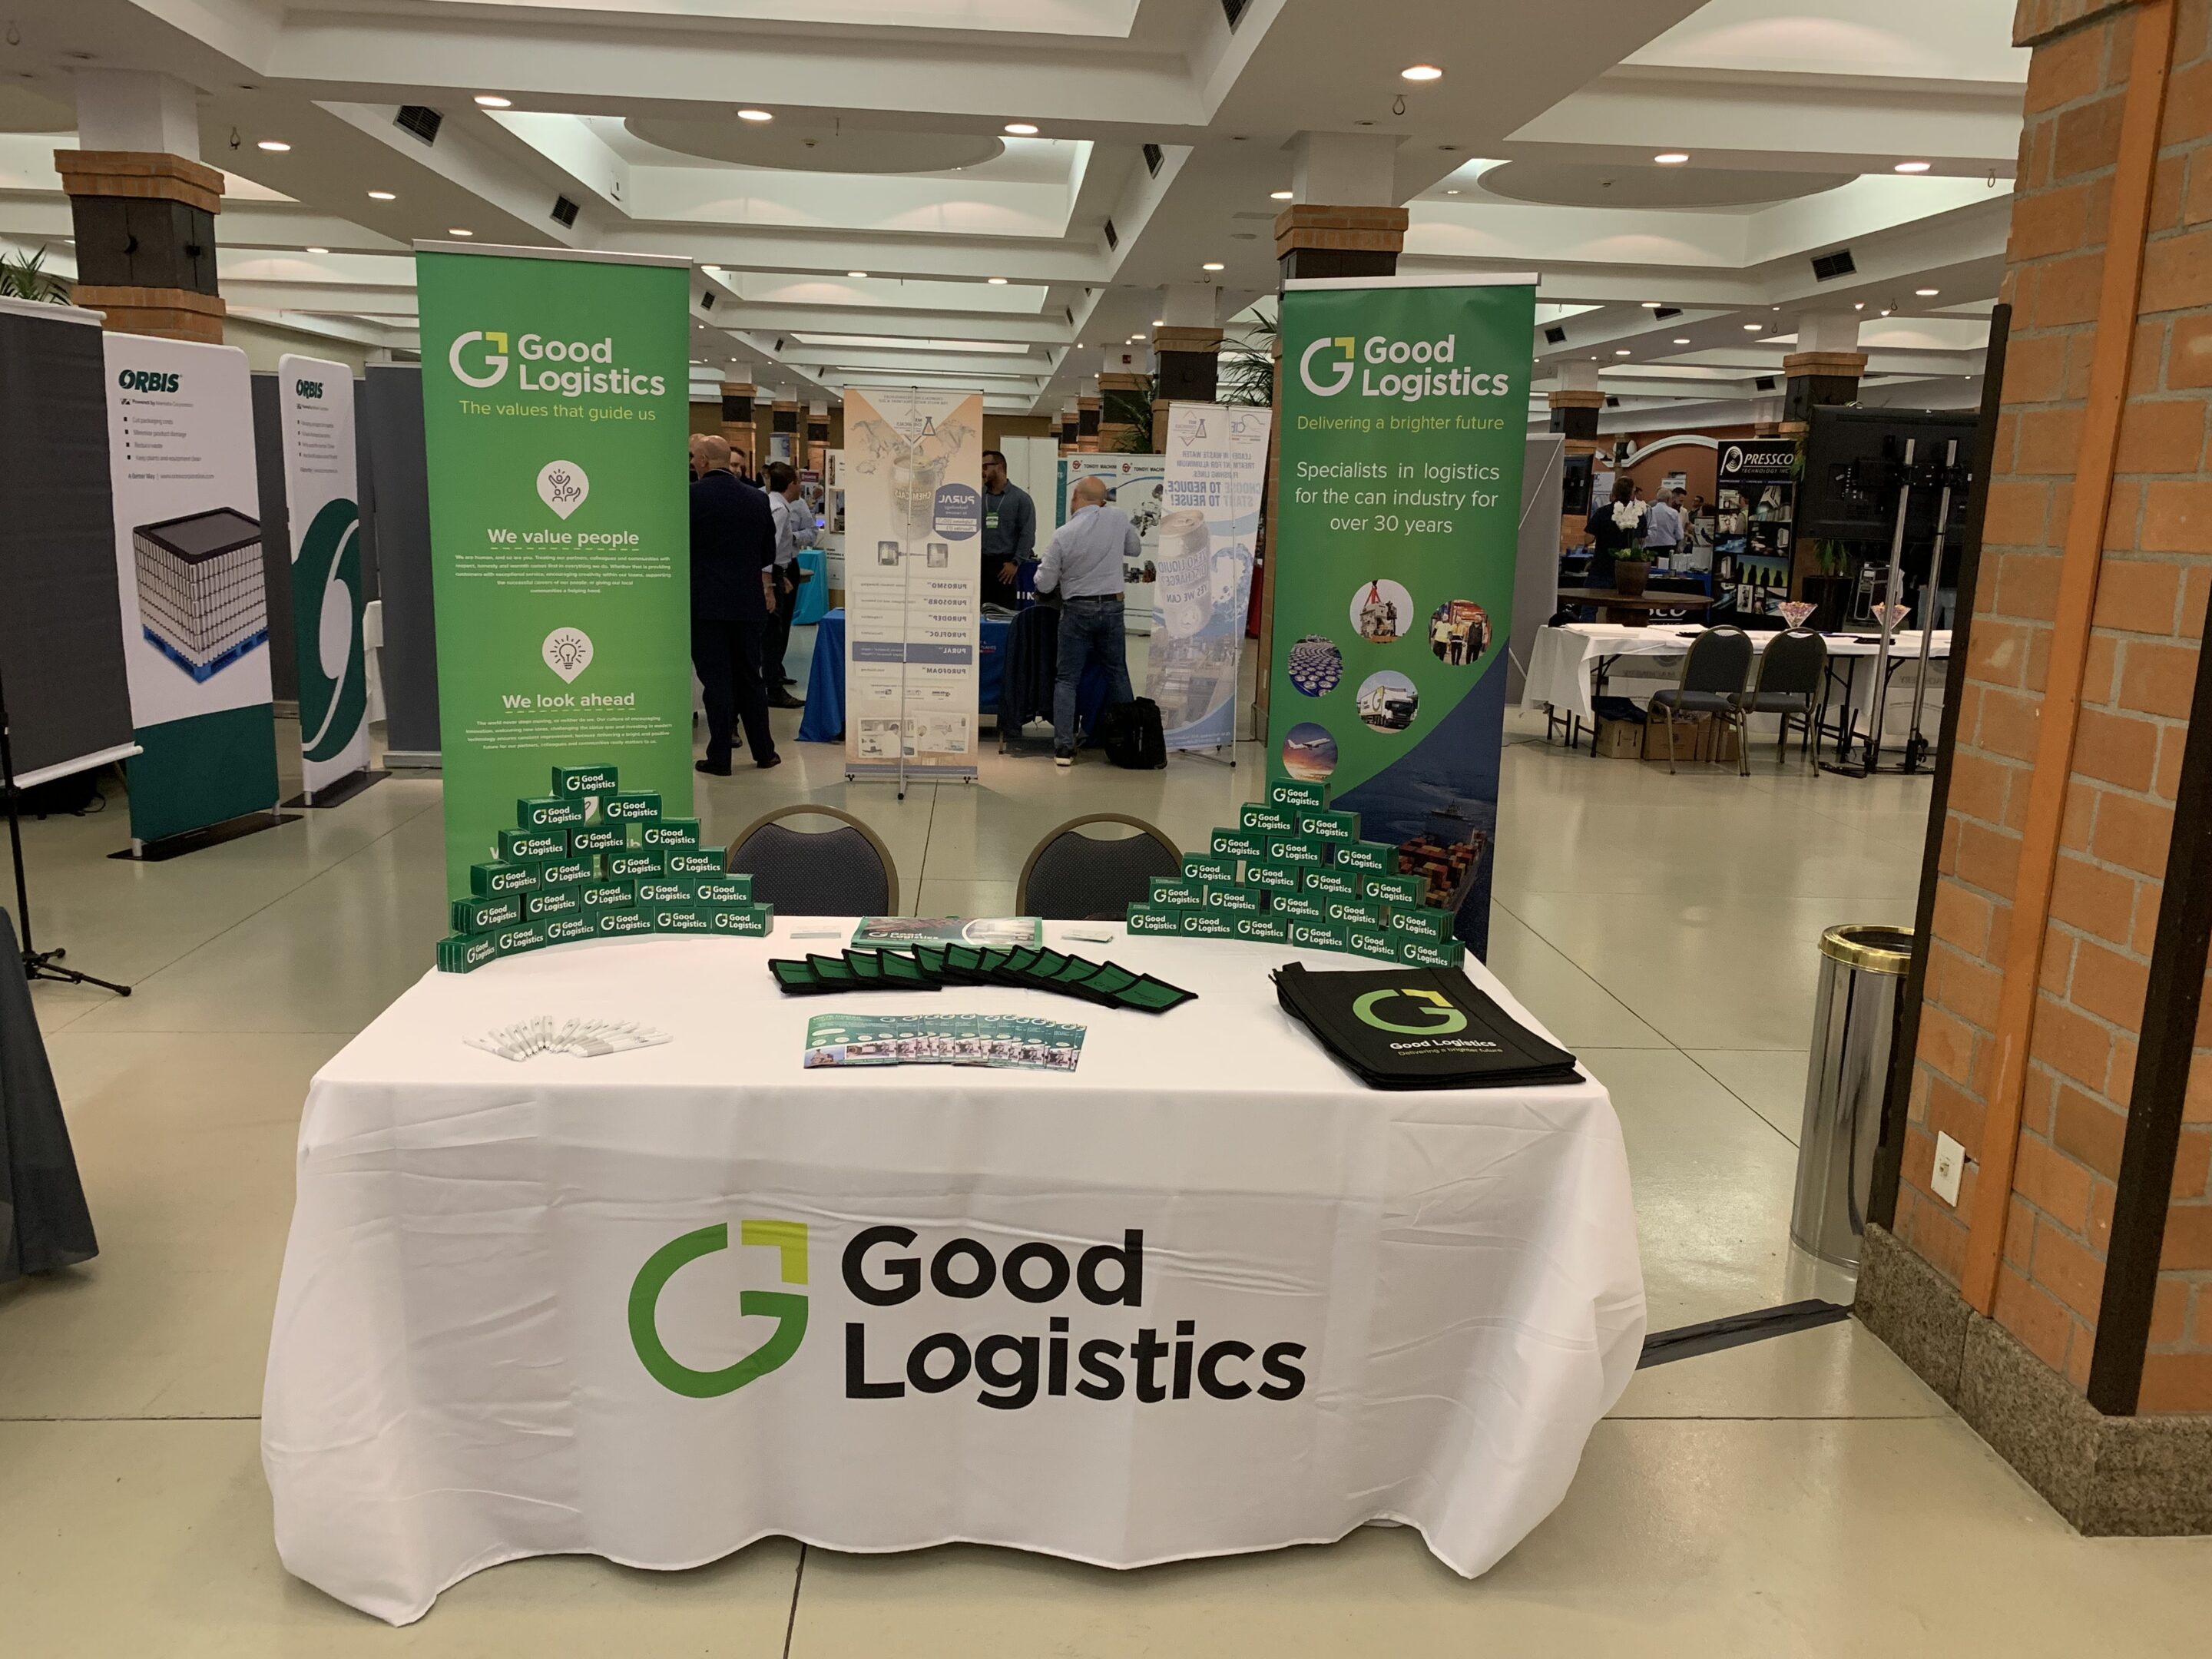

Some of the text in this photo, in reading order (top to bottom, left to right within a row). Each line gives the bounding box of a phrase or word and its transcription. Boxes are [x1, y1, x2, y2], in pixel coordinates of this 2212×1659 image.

[518, 333, 612, 363] Good
[1364, 334, 1455, 363] Good
[118, 369, 180, 393] ORBIS
[519, 364, 665, 397] Logistics
[1362, 367, 1508, 402] Logistics
[296, 379, 323, 399] ORBIS
[459, 400, 656, 422] The values that guide us
[1297, 416, 1505, 432] Delivering a brighter future
[1743, 453, 1794, 465] PRESSCO
[1296, 462, 1500, 483] Specialists in logistics
[1295, 488, 1498, 510] for the can industry for
[1330, 515, 1452, 535] over 30 years
[487, 528, 639, 547] We value people
[502, 693, 634, 708] We look ahead
[582, 780, 615, 790] Logistics
[1287, 797, 1319, 806] Logistics
[548, 806, 570, 815] Good
[623, 809, 657, 817] Logistics
[548, 813, 581, 823] Logistics
[1258, 822, 1290, 830] Logistics
[1316, 828, 1348, 837] Logistics
[528, 838, 551, 846] Good
[661, 836, 695, 845] Logistics
[528, 845, 563, 855] Logistics
[1227, 847, 1260, 856] Logistics
[1351, 852, 1371, 860] Good
[559, 864, 580, 873] Good
[1351, 859, 1382, 869] Logistics
[505, 871, 525, 880] Good
[559, 870, 590, 882] Logistics
[1199, 873, 1230, 881] Logistics
[505, 876, 536, 889] Logistics
[1380, 884, 1401, 892] Good
[545, 894, 565, 903] Good
[713, 892, 747, 901] Logistics
[1380, 892, 1412, 902] Logistics
[489, 905, 507, 916] Good
[545, 900, 575, 912] Logistics
[1344, 906, 1364, 914] Good
[489, 911, 517, 923] Logistics
[1343, 913, 1375, 923] Logistics
[1406, 917, 1426, 926] Good
[729, 922, 761, 930] Logistics
[1406, 924, 1436, 936] Logistics
[513, 929, 533, 939] Good
[1251, 929, 1283, 938] Logistics
[514, 935, 543, 947] Logistics
[475, 941, 488, 952] Good
[1418, 946, 1437, 956] Good
[475, 945, 495, 961] Logistics
[1417, 954, 1448, 965] Logistics
[1390, 1040, 1431, 1049] Good
[1398, 1048, 1440, 1056] Delivering
[842, 1225, 1144, 1307] Good
[845, 1316, 1306, 1409] Logistics
